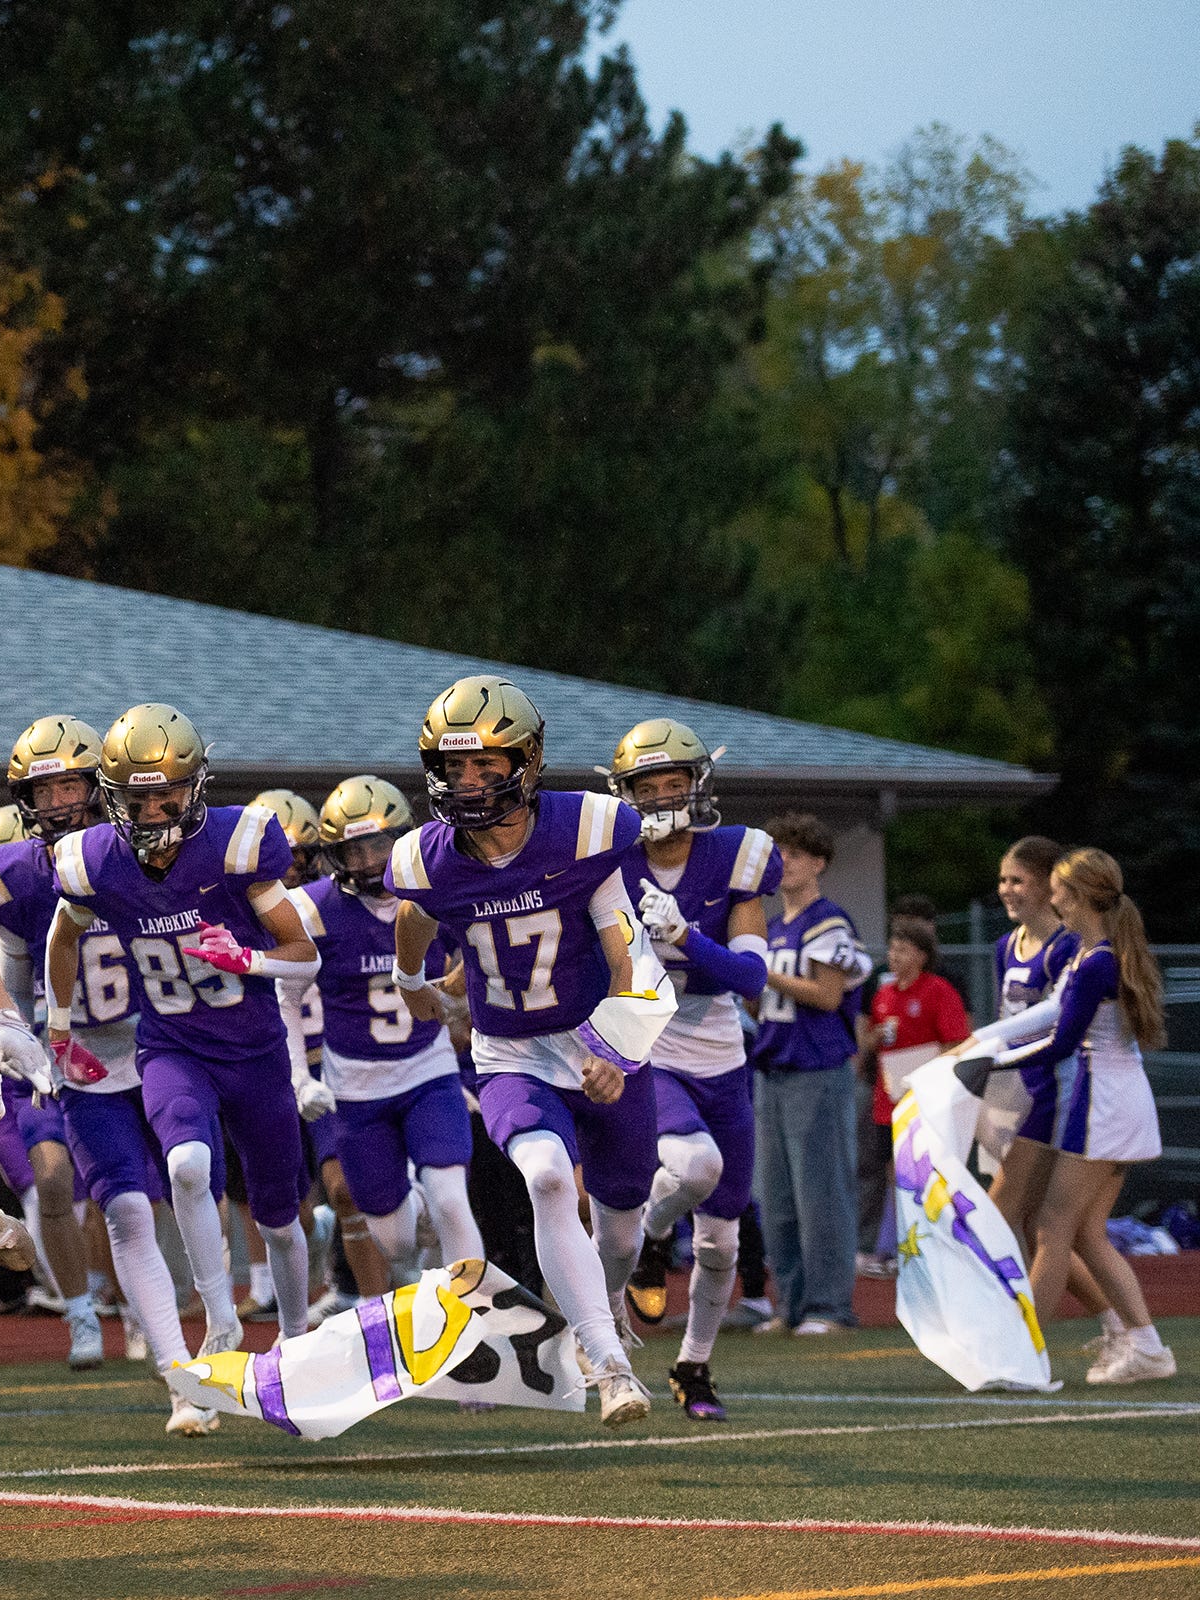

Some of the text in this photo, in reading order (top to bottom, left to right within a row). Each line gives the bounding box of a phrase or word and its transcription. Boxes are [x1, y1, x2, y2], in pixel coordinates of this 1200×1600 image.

[442, 737, 477, 747] Riddell
[31, 762, 61, 773] Riddell
[132, 774, 162, 783] Riddell
[138, 909, 201, 934] LAMBKINS
[130, 923, 245, 1015] 85
[465, 908, 563, 1011] 17
[368, 972, 414, 1044] 9
